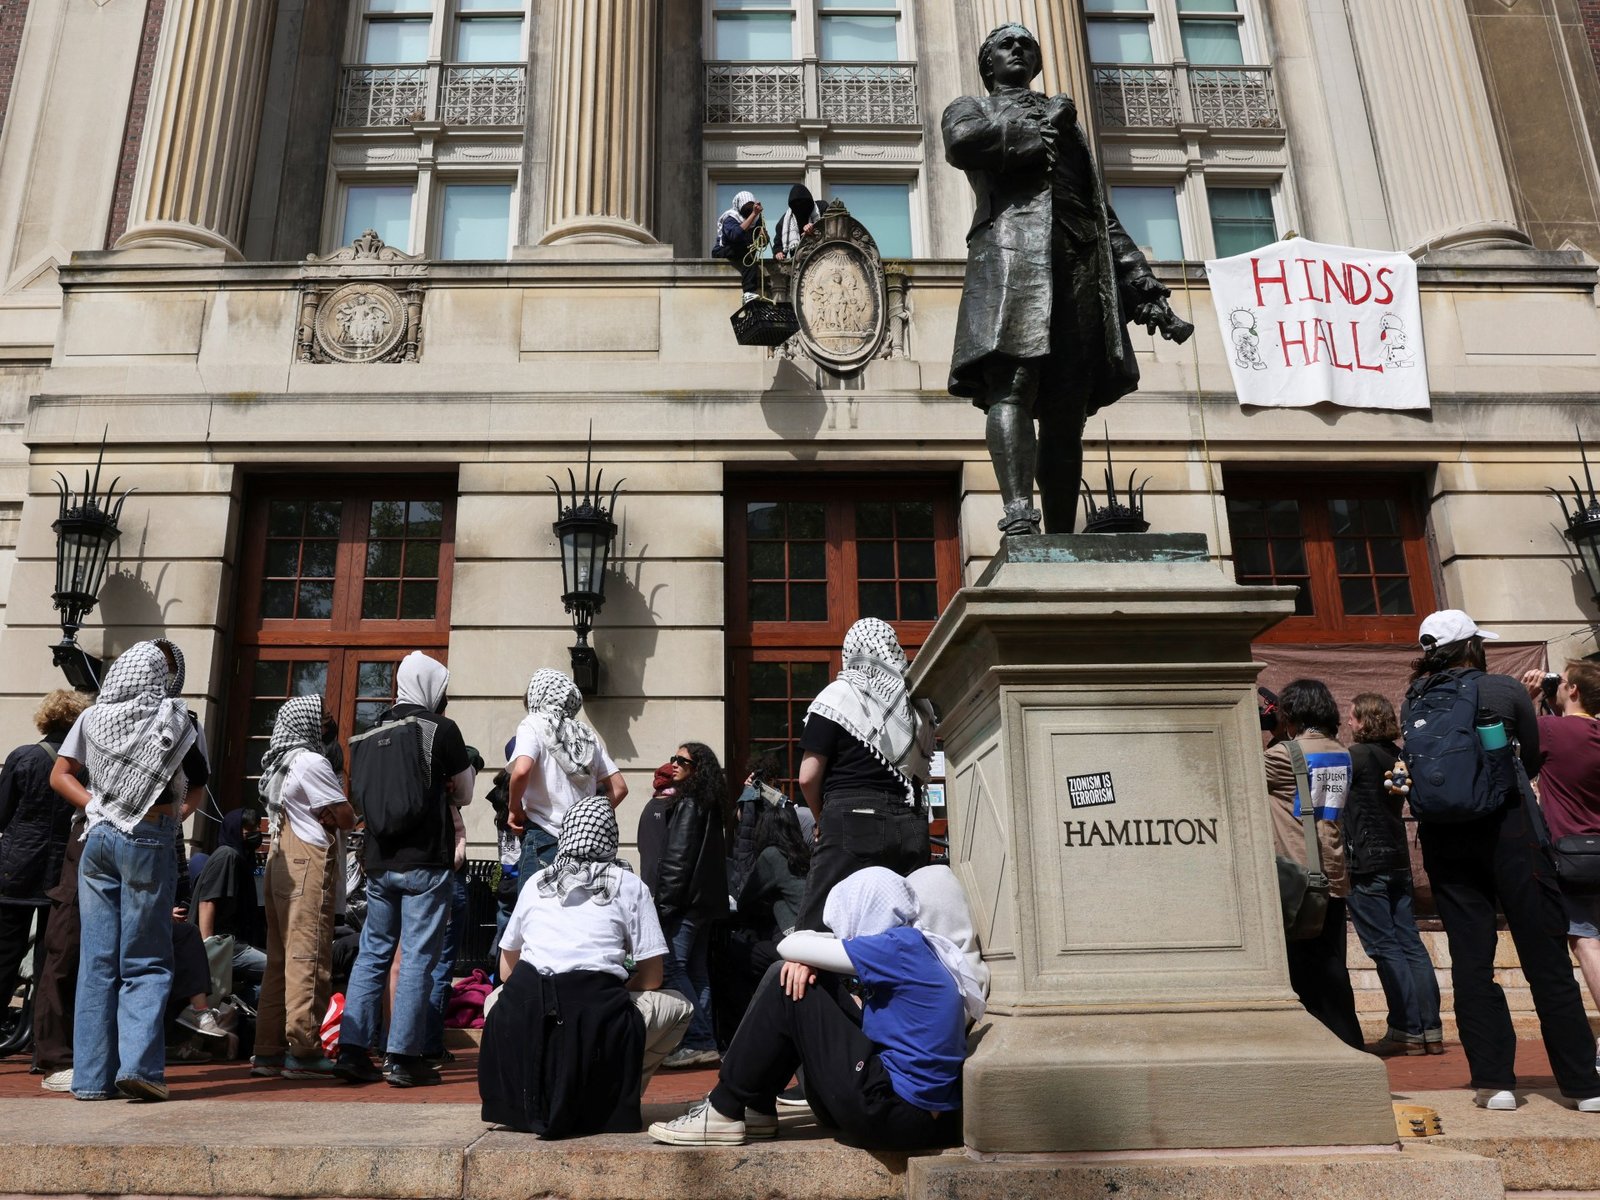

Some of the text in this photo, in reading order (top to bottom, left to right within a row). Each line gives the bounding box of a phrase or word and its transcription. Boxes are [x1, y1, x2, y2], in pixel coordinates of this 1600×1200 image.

[1277, 317, 1384, 374] HALL
[1068, 773, 1112, 792] ZIONISM IS
[1321, 784, 1343, 793] PRESS
[1070, 787, 1114, 806] TERRORISM
[1063, 818, 1218, 847] HAMILTON
